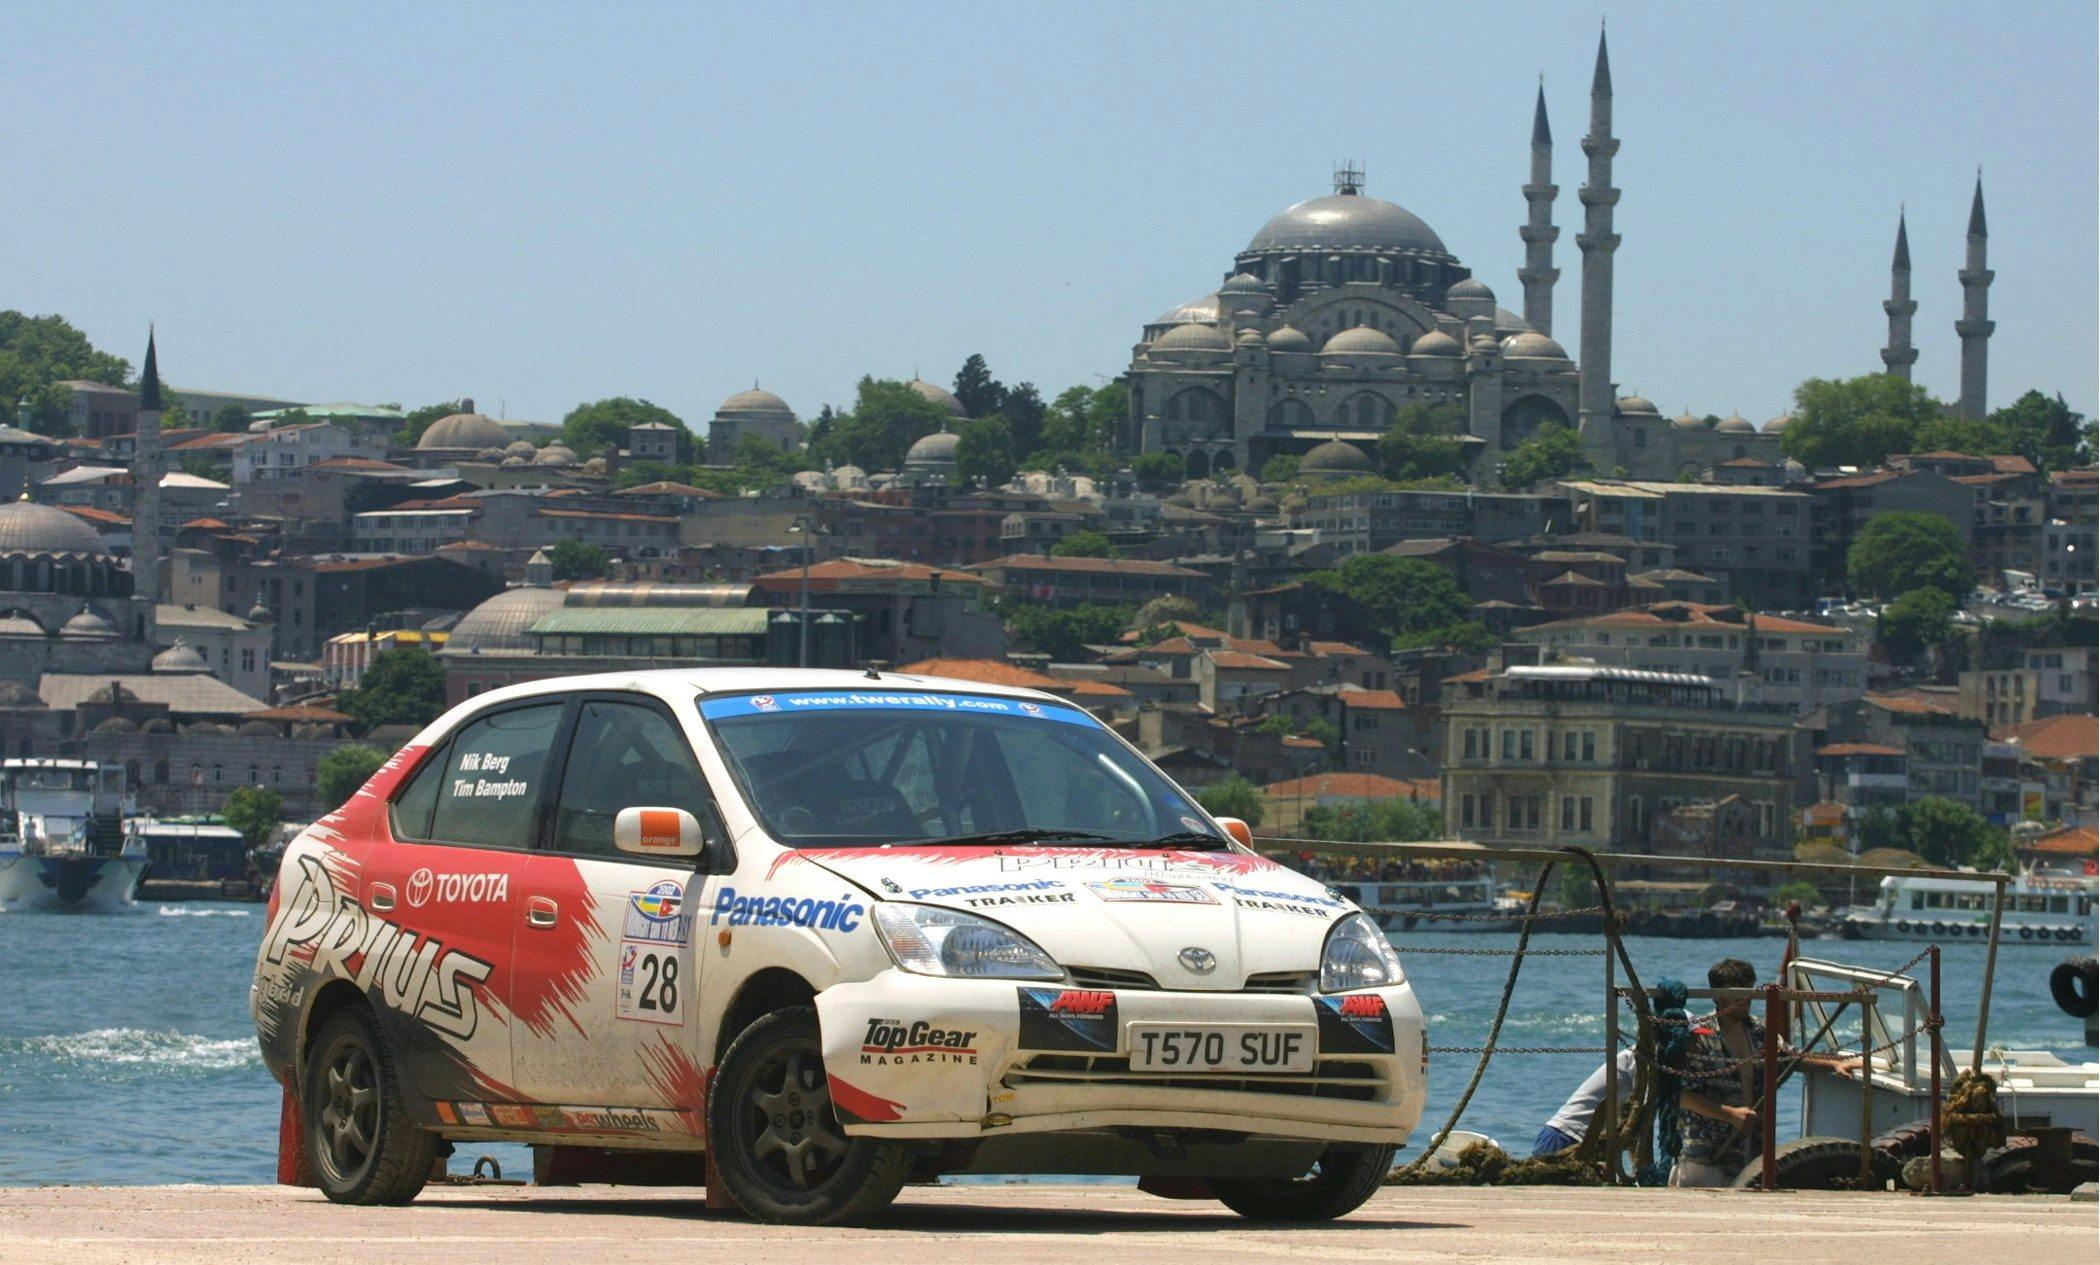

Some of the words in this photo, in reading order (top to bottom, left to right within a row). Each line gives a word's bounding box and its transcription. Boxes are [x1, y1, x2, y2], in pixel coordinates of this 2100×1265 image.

[788, 693, 1010, 711] www.twerally.com
[460, 753, 481, 770] Nik
[481, 753, 510, 774] Berg
[453, 779, 474, 797] Tim
[475, 778, 528, 801] Bampton
[436, 873, 509, 902] TOYOTA
[909, 878, 1066, 900] Panasonic
[711, 886, 864, 933] Panasonic
[639, 953, 679, 1013] 28
[861, 1054, 977, 1066] MAGAZINE
[1141, 1031, 1224, 1066] T570
[1240, 1031, 1303, 1066] SUF
